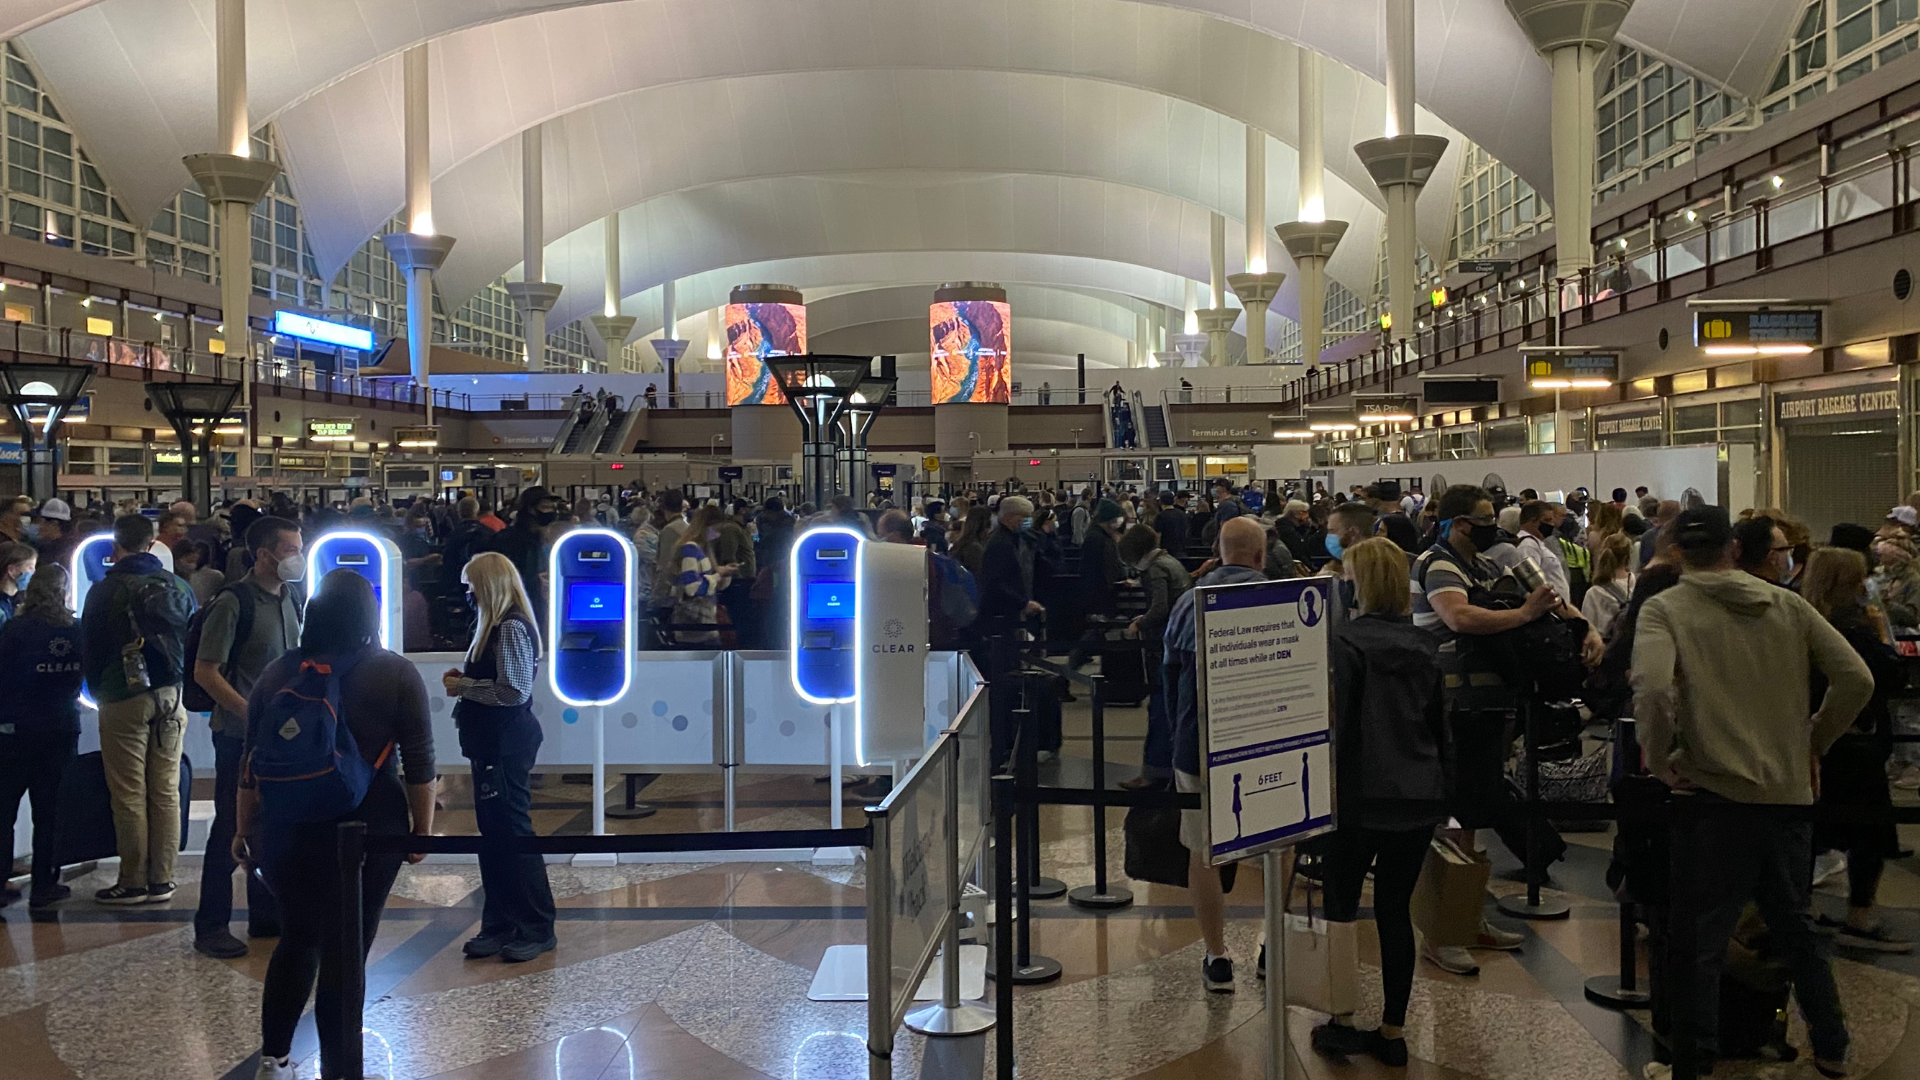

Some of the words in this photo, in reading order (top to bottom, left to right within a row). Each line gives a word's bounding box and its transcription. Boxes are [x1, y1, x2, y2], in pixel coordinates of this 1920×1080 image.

[1364, 404, 1382, 414] TSA
[1383, 404, 1399, 413] Pre
[1781, 399, 1816, 418] AIRPORT
[1818, 394, 1857, 416] BAGGAGE
[1859, 390, 1898, 412] CENTER
[1191, 428, 1227, 437] Terminal
[1230, 428, 1248, 436] East
[1598, 420, 1618, 434] AIRPORT
[1619, 418, 1642, 432] BAGGAGE
[504, 436, 538, 444] Terminal
[1209, 625, 1236, 638] Federal
[1237, 625, 1251, 635] Law
[1252, 622, 1280, 634] requires
[1281, 620, 1295, 629] that
[872, 644, 914, 653] CLEAR
[1210, 644, 1218, 654] all
[1220, 638, 1257, 652] individuals
[1258, 638, 1275, 647] wear
[1282, 634, 1300, 644] mask
[1210, 661, 1218, 670] at
[1218, 658, 1228, 668] all
[1228, 656, 1248, 667] times
[1249, 654, 1268, 664] while
[1268, 652, 1276, 660] at
[1276, 649, 1292, 660] DEN
[36, 661, 81, 673] CLEAR
[1258, 774, 1264, 786] 6
[1264, 772, 1283, 784] FEET
